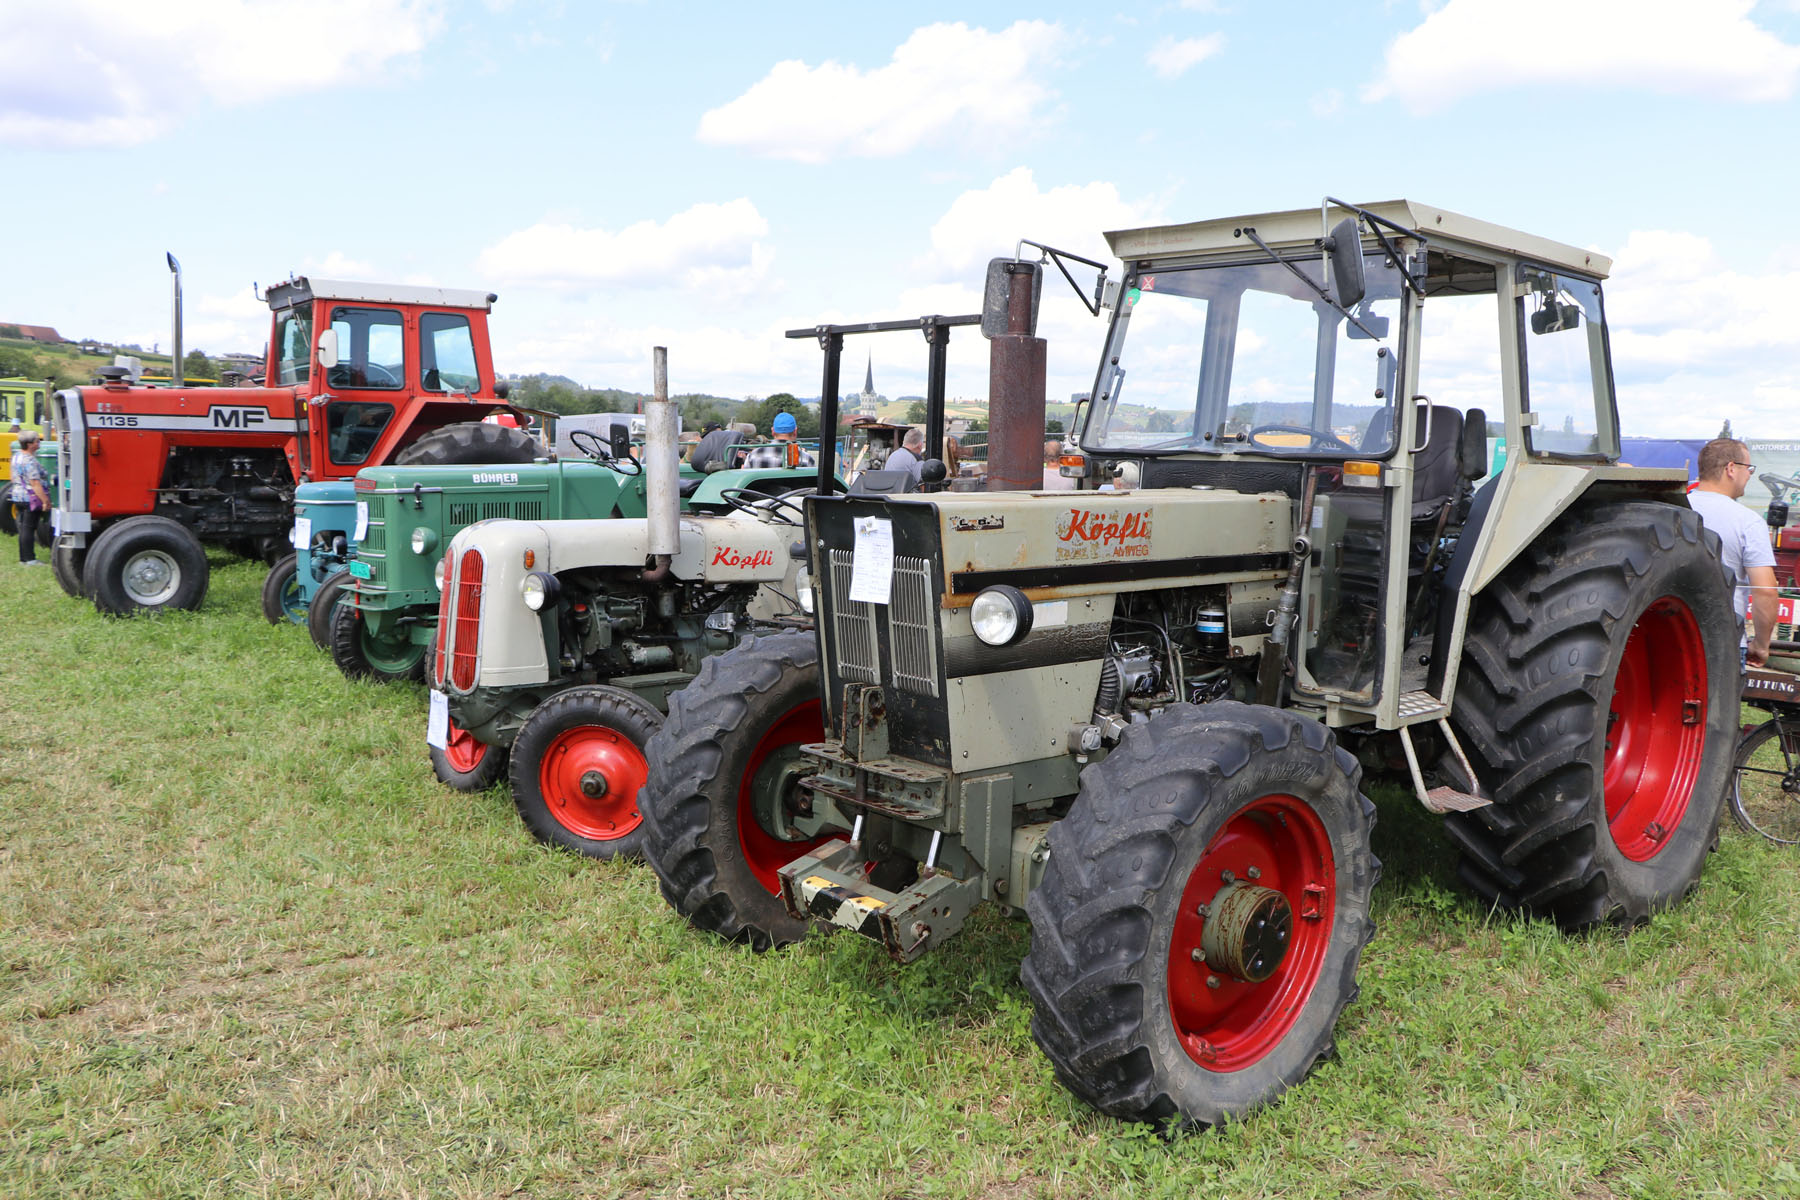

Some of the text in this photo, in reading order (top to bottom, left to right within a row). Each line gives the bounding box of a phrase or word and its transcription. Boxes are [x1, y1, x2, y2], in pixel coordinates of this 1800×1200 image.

[98, 416, 139, 427] 1135
[213, 409, 265, 428] MF
[1059, 508, 1149, 546] Köpfli
[1747, 679, 1795, 692] EITUNG
